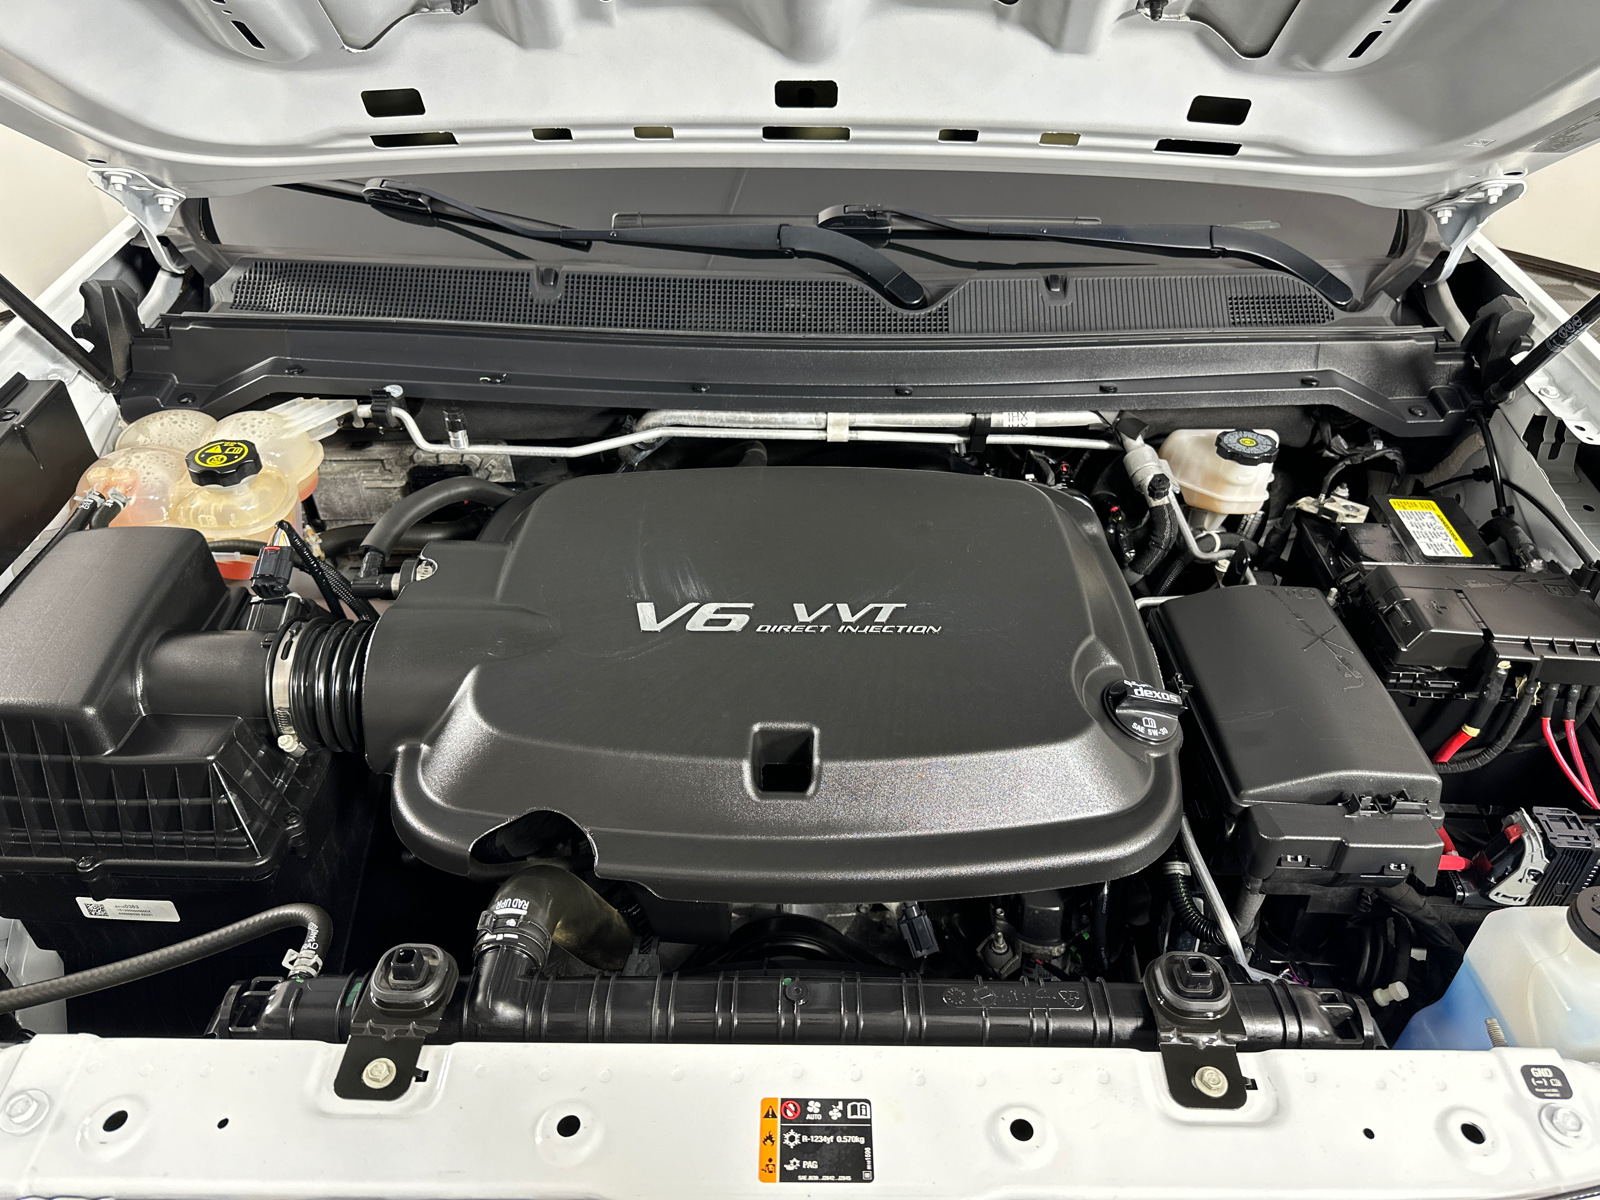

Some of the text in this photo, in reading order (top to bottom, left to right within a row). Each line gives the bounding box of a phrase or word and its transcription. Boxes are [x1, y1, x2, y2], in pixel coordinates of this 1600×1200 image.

[636, 602, 755, 632] V6
[793, 603, 907, 623] VVT
[755, 625, 943, 634] DIRECT INJECTION
[1133, 687, 1179, 703] dexos
[1131, 722, 1146, 734] SAE
[495, 898, 530, 910] RAD UPR
[1530, 1067, 1554, 1078] GND
[801, 1135, 865, 1144] R-1234yf 0.570kg
[802, 1160, 818, 1169] PAG
